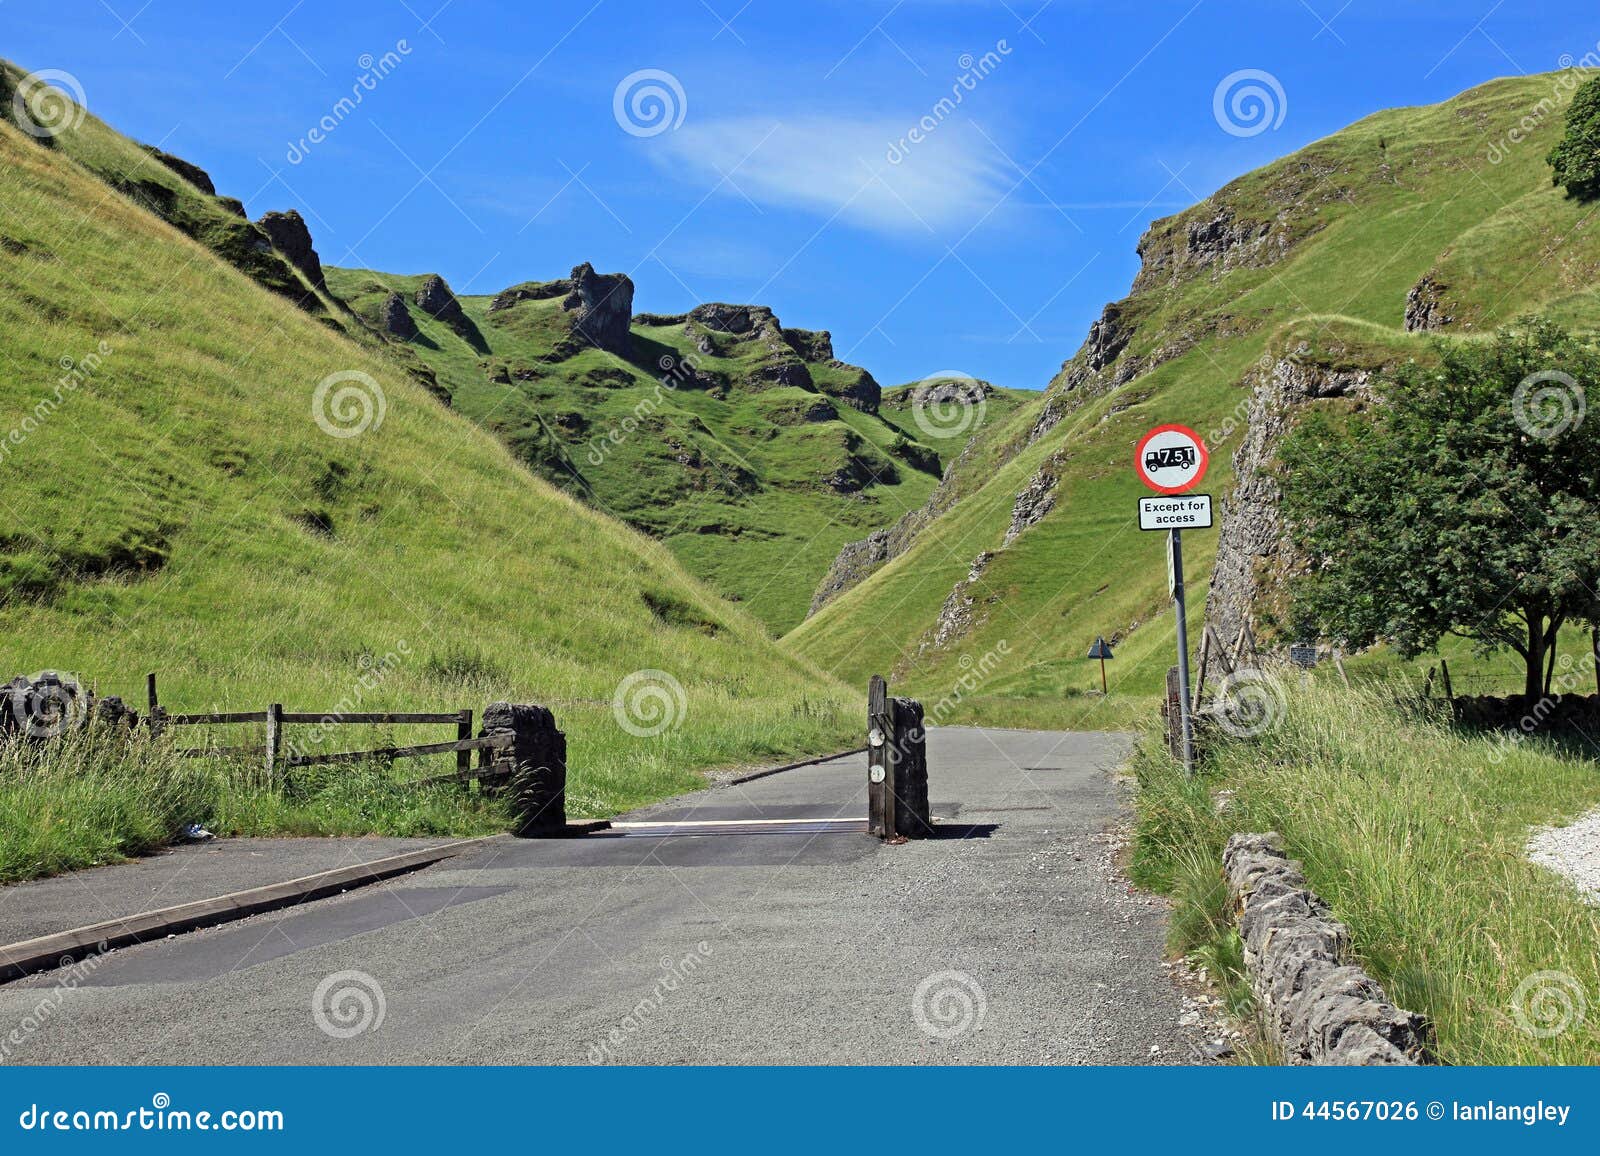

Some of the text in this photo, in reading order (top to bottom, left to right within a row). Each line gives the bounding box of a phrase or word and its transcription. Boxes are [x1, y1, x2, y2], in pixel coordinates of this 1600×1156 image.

[1160, 447, 1193, 464] 7.5T
[1144, 501, 1205, 513] Except for
[1156, 514, 1195, 524] access
